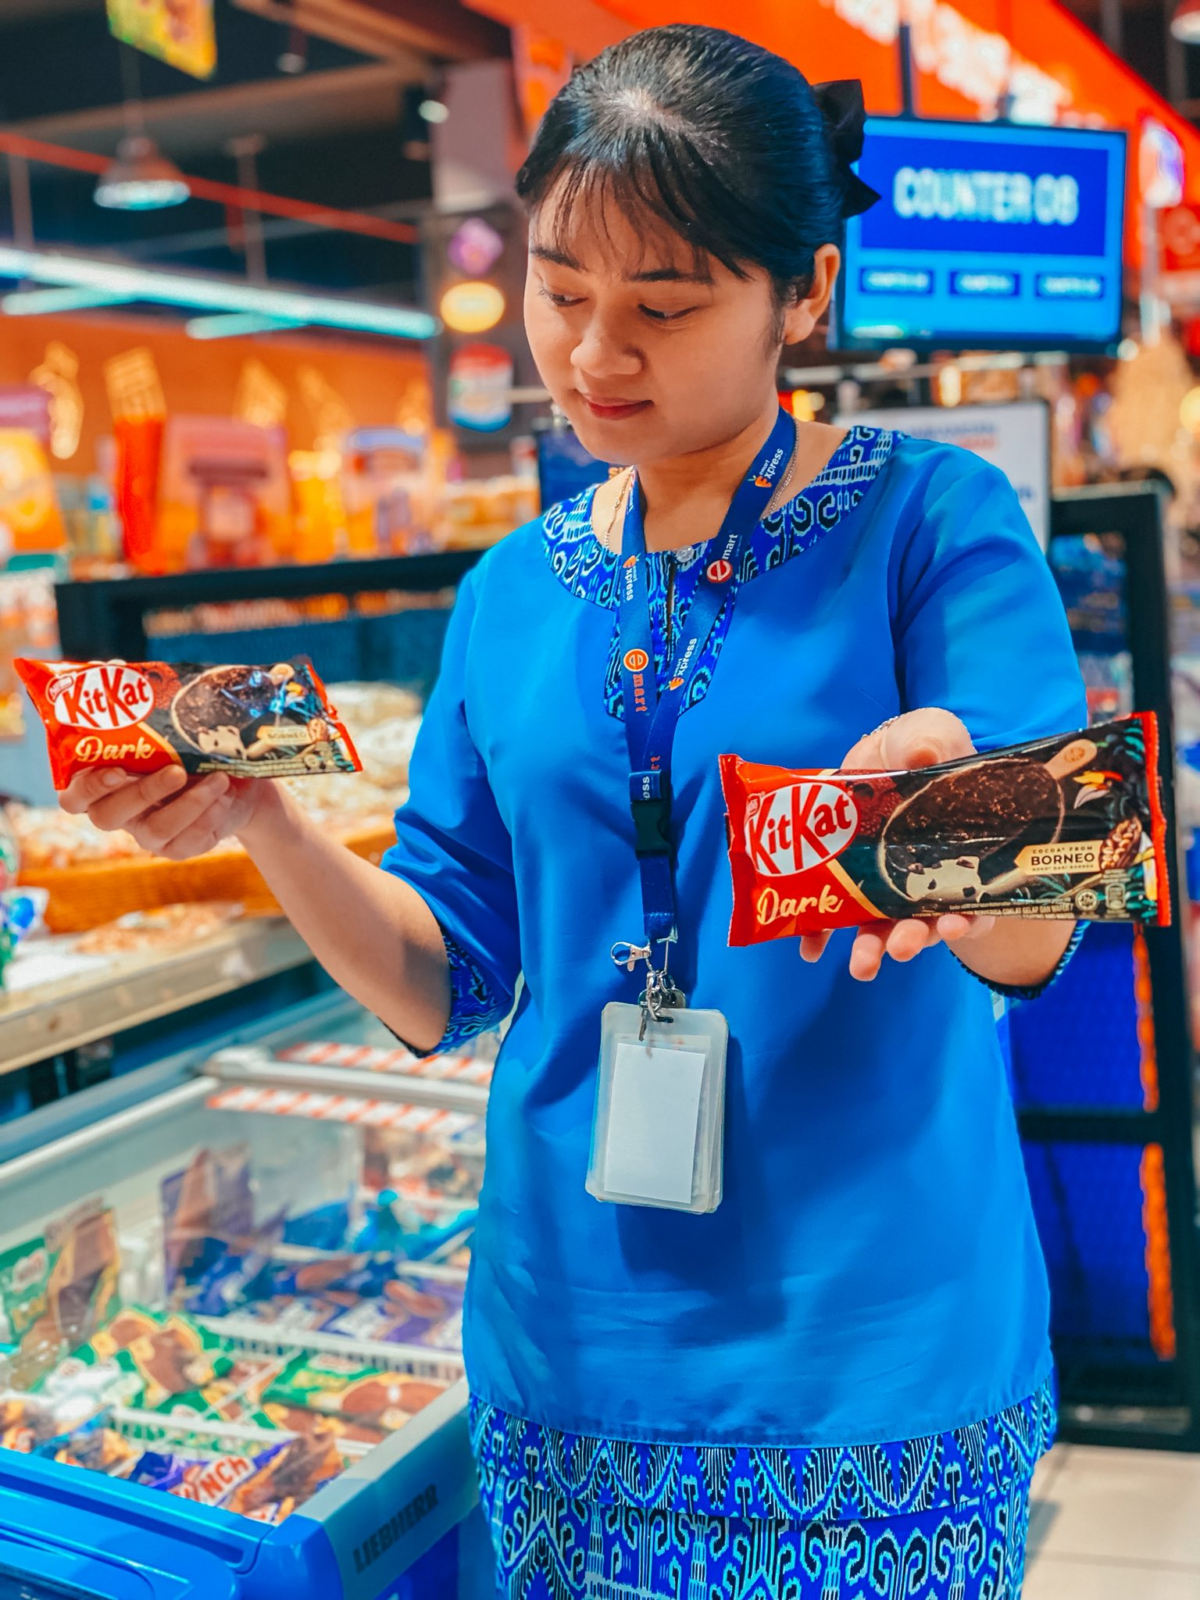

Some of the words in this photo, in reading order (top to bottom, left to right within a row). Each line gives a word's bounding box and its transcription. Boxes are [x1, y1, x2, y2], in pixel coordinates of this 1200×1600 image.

[893, 167, 1033, 225] COUNTER
[62, 666, 150, 728] KitKat
[75, 735, 156, 762] Dark
[749, 784, 853, 875] KitKat
[1031, 852, 1095, 865] BORNEO
[757, 884, 844, 925] Dark
[352, 1483, 438, 1574] LIEBHERR
